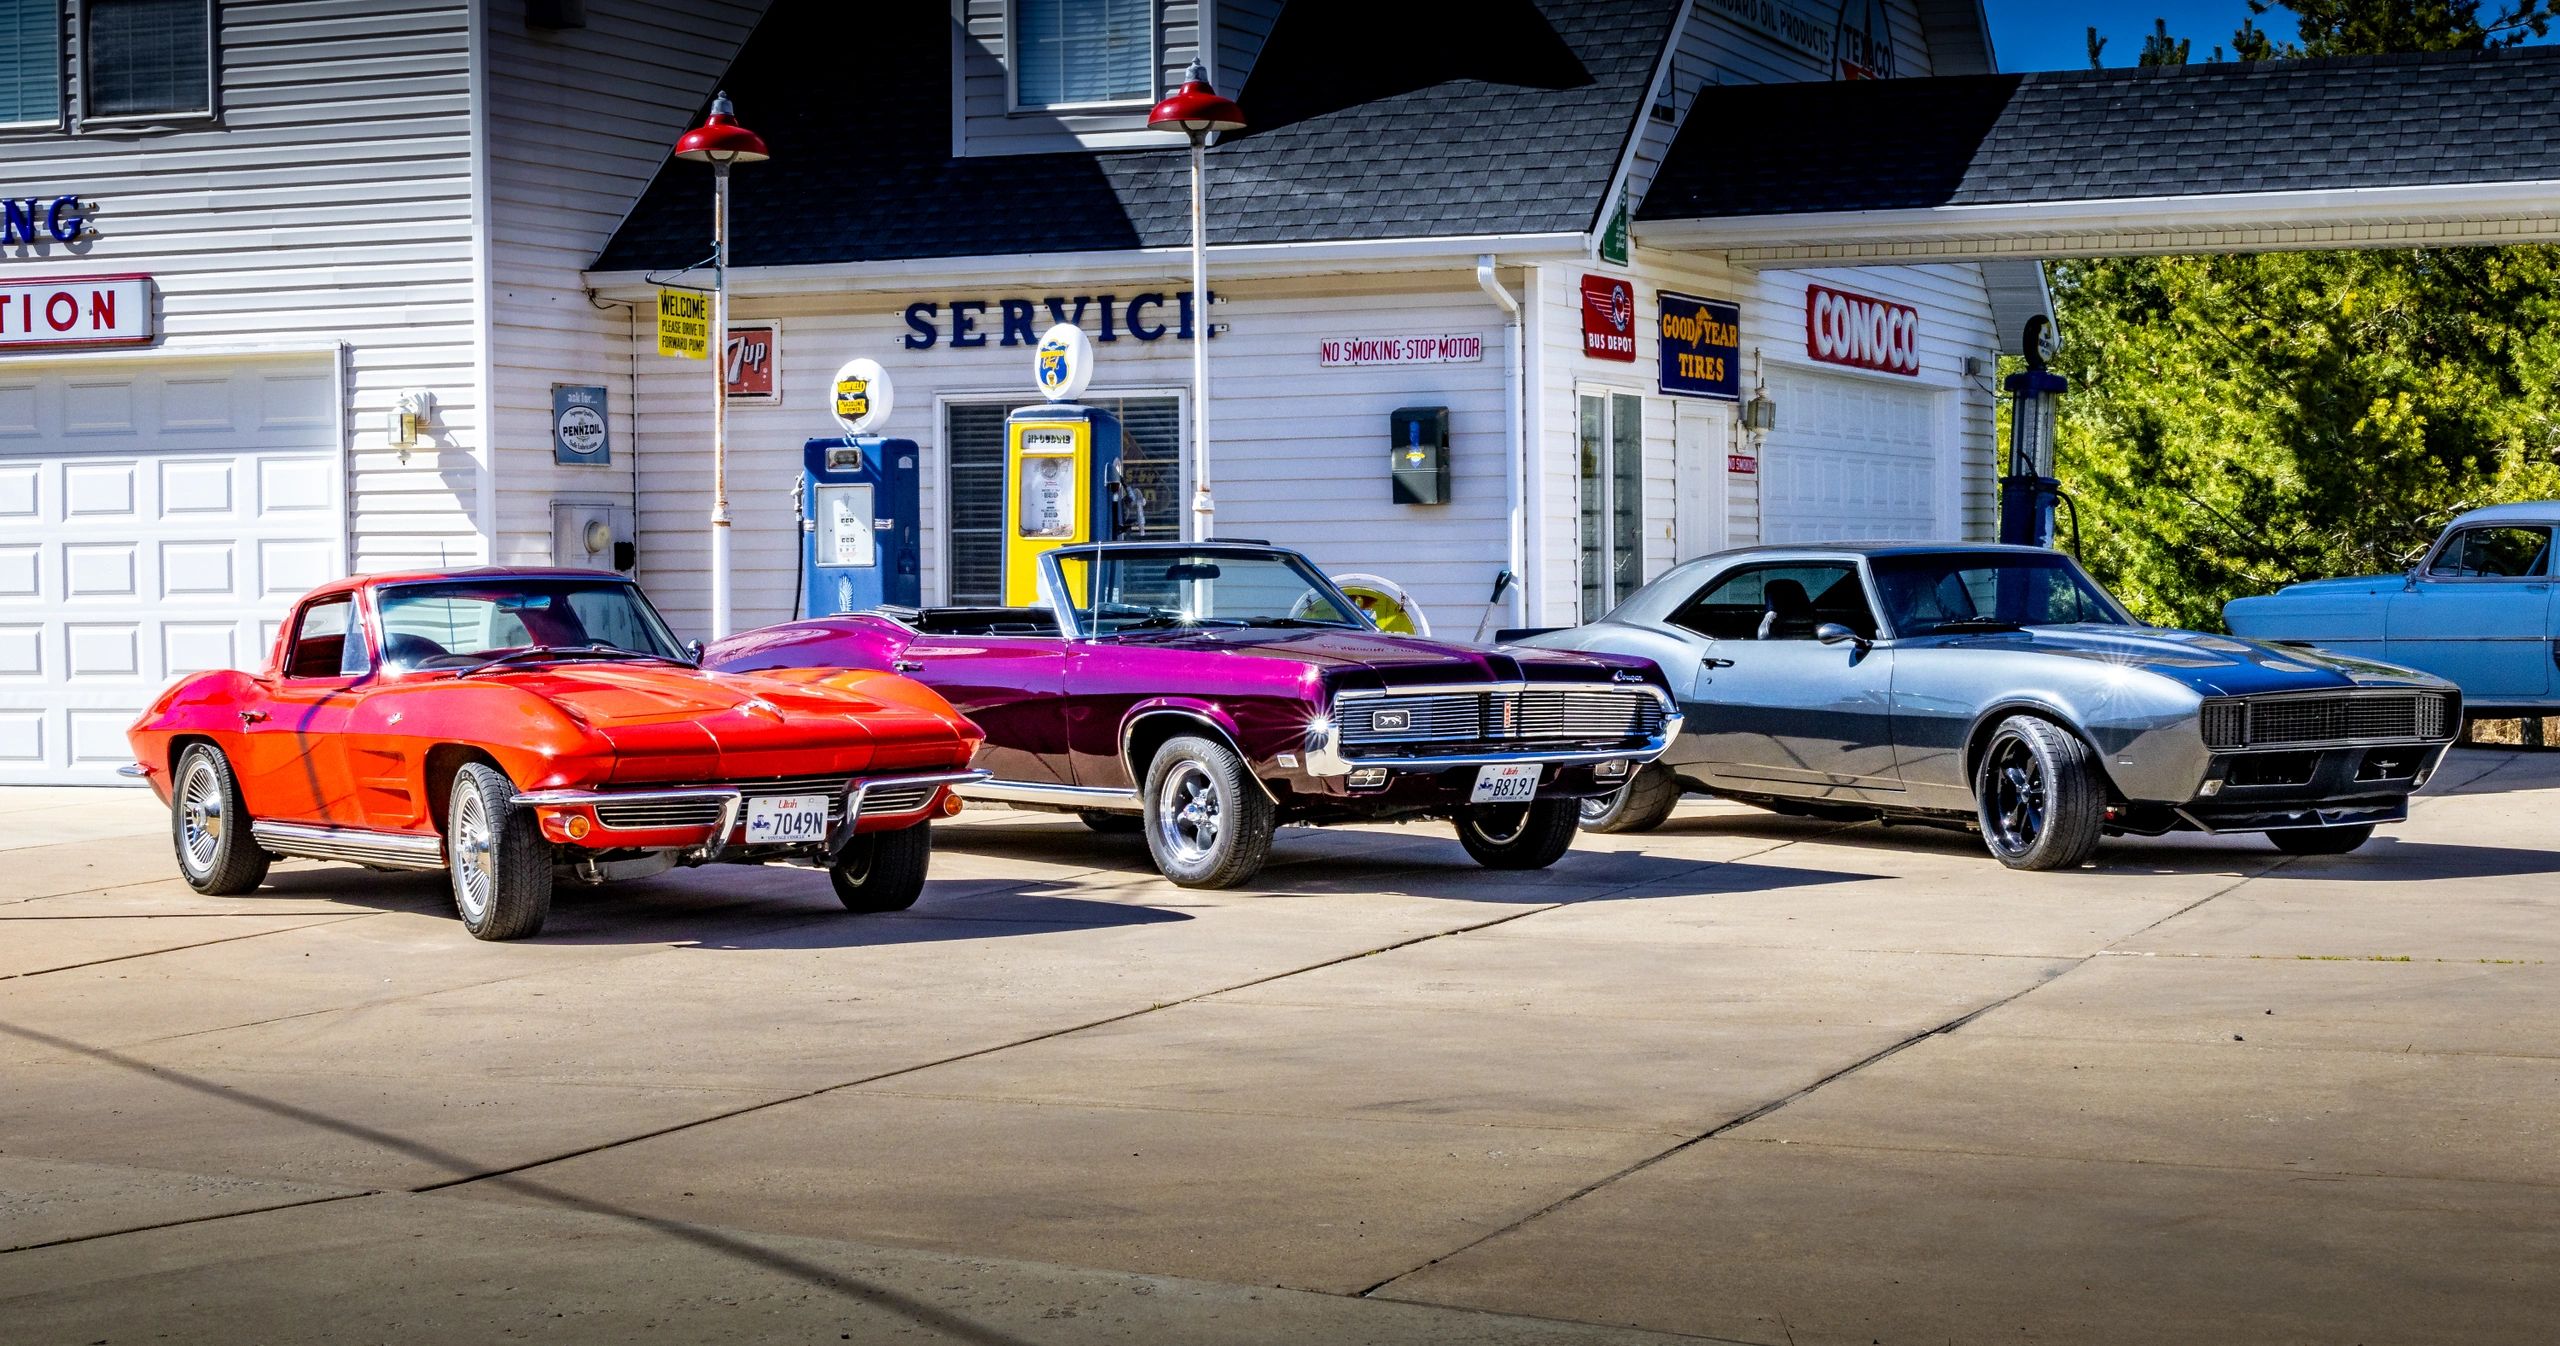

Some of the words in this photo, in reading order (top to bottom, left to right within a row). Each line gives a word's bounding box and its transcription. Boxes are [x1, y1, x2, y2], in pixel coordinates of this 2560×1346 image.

[1760, 1, 1777, 31] OIL
[1780, 9, 1829, 56] PRODUCTS
[1843, 23, 1891, 78] TEXACO
[660, 294, 705, 320] WELCOME
[661, 320, 681, 334] PLEASE
[682, 322, 698, 336] DRIVE
[699, 324, 706, 337] TO
[904, 291, 1215, 350] SERVICE
[1814, 290, 1919, 371] CONOCO
[661, 335, 687, 350] FORWARD
[688, 339, 704, 352] PUMP
[1322, 342, 1340, 362] NO
[1439, 337, 1479, 358] MOTOR
[1588, 333, 1605, 349] BUS
[1608, 336, 1632, 353] DEPOT
[1678, 353, 1725, 382] TIRES
[563, 424, 602, 437] PENNZOIL
[1612, 669, 1643, 683] Cougar
[1502, 767, 1519, 775] Utah
[1492, 778, 1535, 796] B819J
[778, 799, 798, 809] Utah
[774, 812, 823, 835] 7049N
